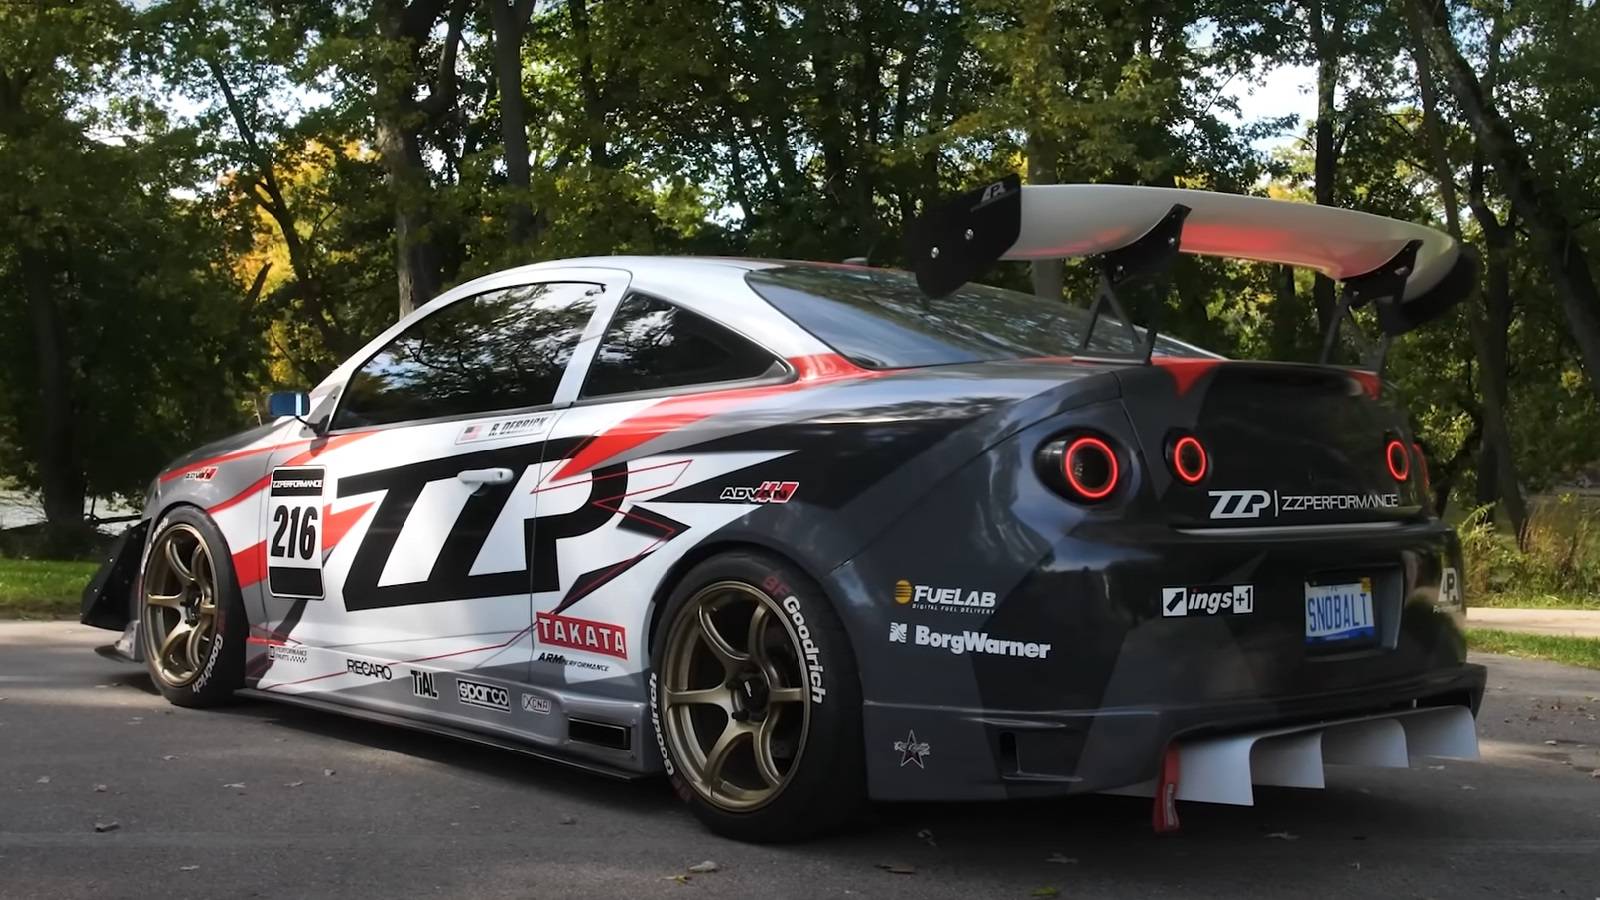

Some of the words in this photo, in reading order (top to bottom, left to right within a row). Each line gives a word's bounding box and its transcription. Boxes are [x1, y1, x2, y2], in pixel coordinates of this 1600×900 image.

[720, 481, 799, 503] ADVAN
[1208, 490, 1271, 519] ZZP
[1282, 494, 1398, 510] ZZPERFORMANCE
[271, 505, 318, 560] 216
[914, 585, 996, 608] FUELAB
[1307, 593, 1368, 632] SNOBALT
[538, 617, 625, 654] TAKATA
[784, 596, 826, 704] Goodrich
[915, 625, 1051, 659] BorgWarner
[192, 634, 223, 693] Goodrich
[346, 659, 392, 681] RECARO
[410, 670, 438, 698] TiAL
[460, 682, 508, 706] sparco
[650, 672, 675, 776] Goodrich
